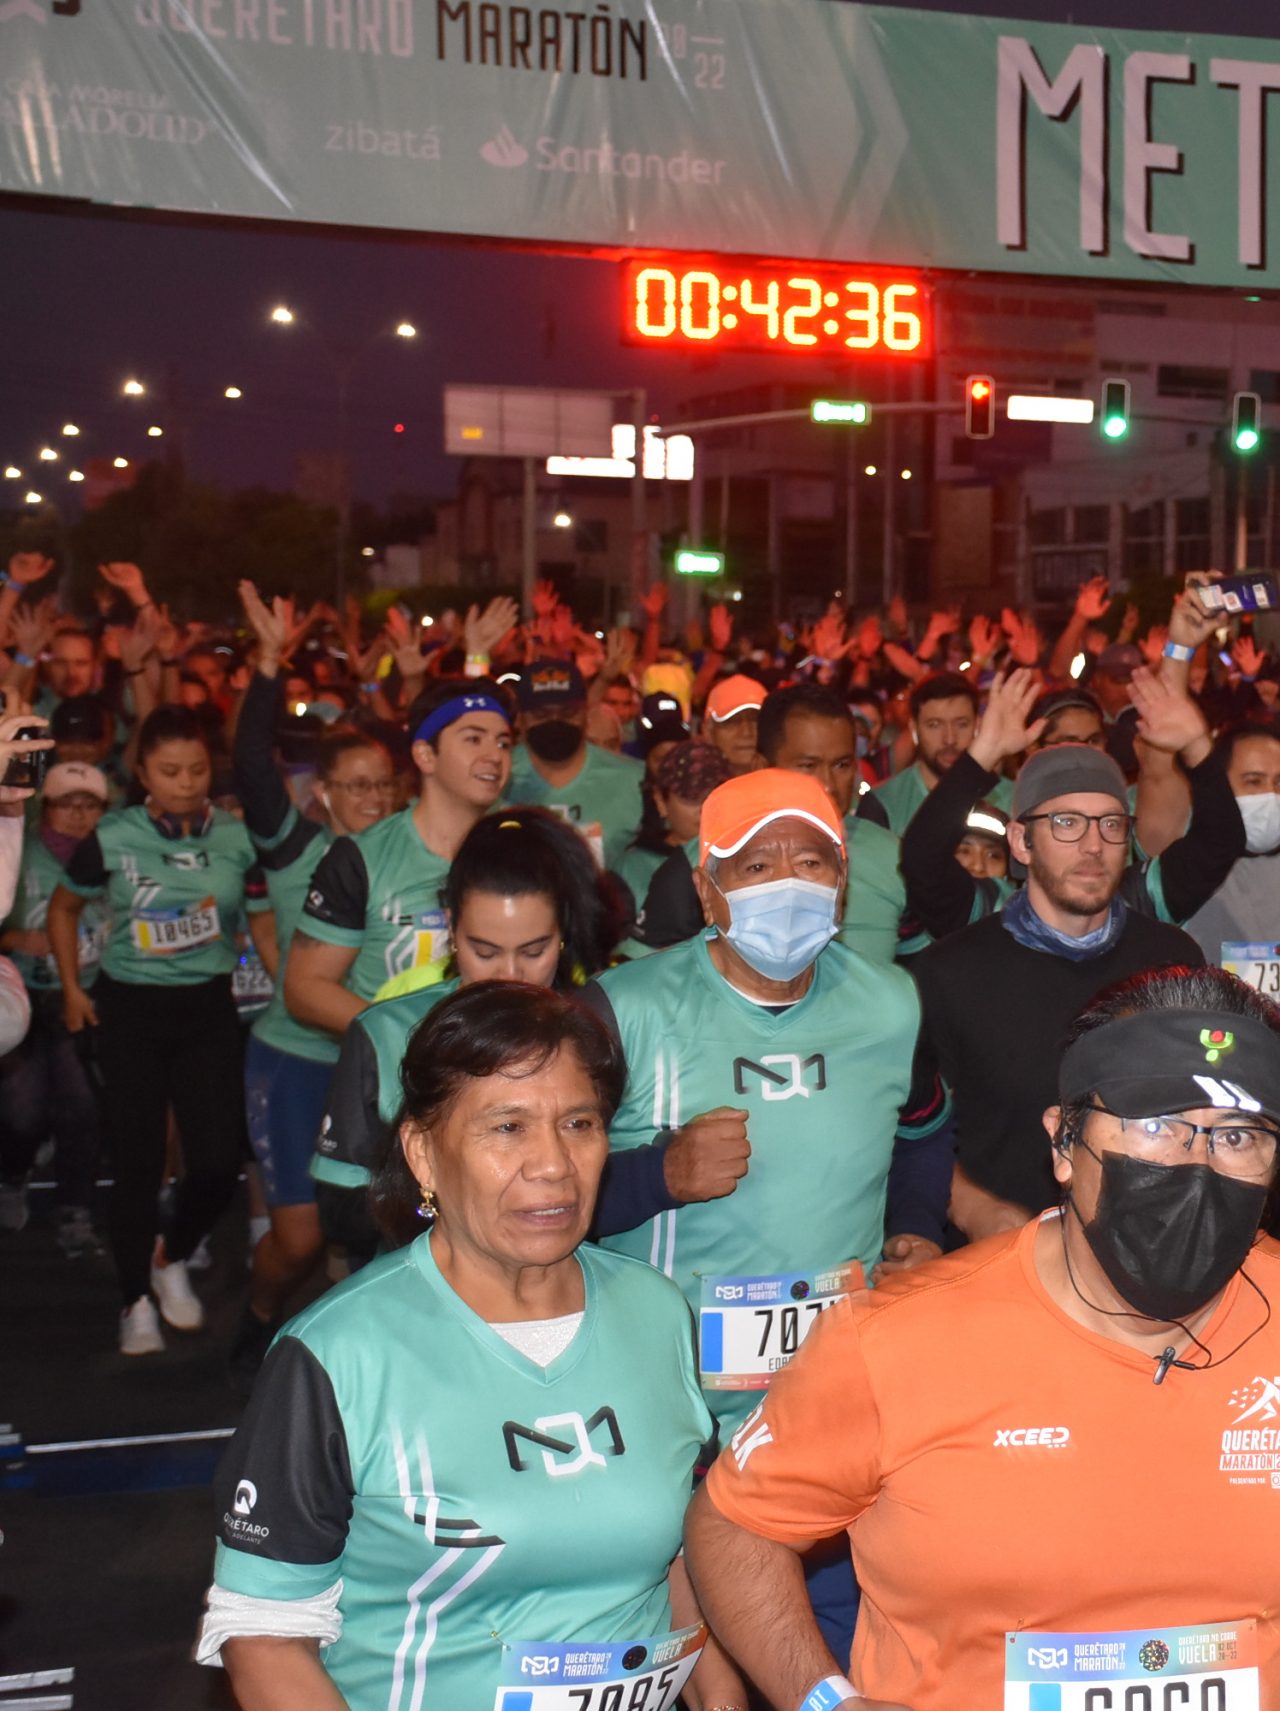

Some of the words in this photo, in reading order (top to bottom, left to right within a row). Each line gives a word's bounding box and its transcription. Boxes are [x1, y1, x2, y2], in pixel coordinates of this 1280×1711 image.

[436, 0, 647, 81] MARATÓN
[325, 121, 442, 161] zibatá
[535, 136, 727, 186] Santander
[636, 268, 921, 351] 00:42:36
[755, 1301, 834, 1357] 70
[993, 1426, 1070, 1448] XCEED
[1221, 1454, 1273, 1469] MARATÓN
[565, 1651, 605, 1664] QUERÉTARO
[652, 1643, 682, 1665] VUELA
[1074, 1642, 1118, 1657] QUERÉTARO
[1178, 1644, 1217, 1665] VUELA
[563, 1662, 602, 1677] MARATÓN
[1074, 1655, 1119, 1672] MARATÓN
